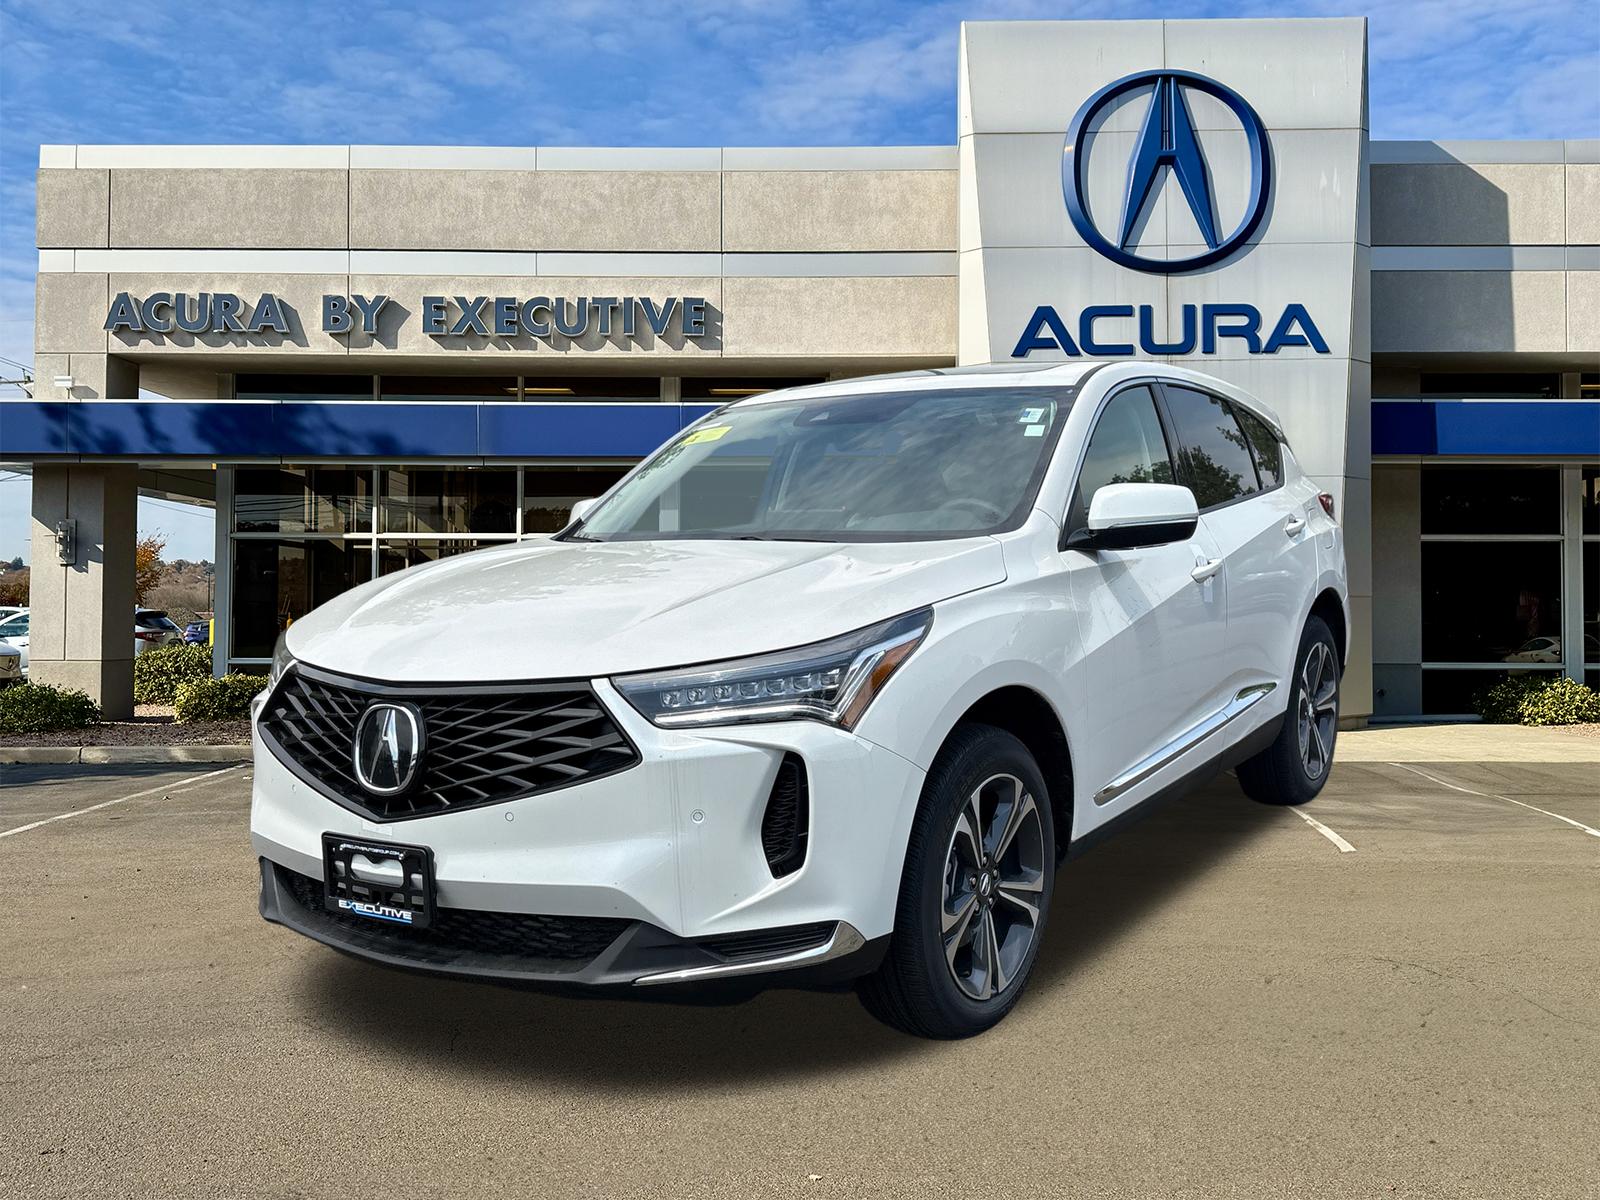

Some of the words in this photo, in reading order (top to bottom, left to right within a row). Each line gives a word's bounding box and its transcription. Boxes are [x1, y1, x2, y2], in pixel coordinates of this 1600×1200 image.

[104, 291, 289, 334] ACURA
[322, 294, 390, 334] BY
[421, 295, 707, 338] EXECUTIVE
[1010, 303, 1333, 357] ACURA
[338, 899, 413, 921] EXECUTIVE
